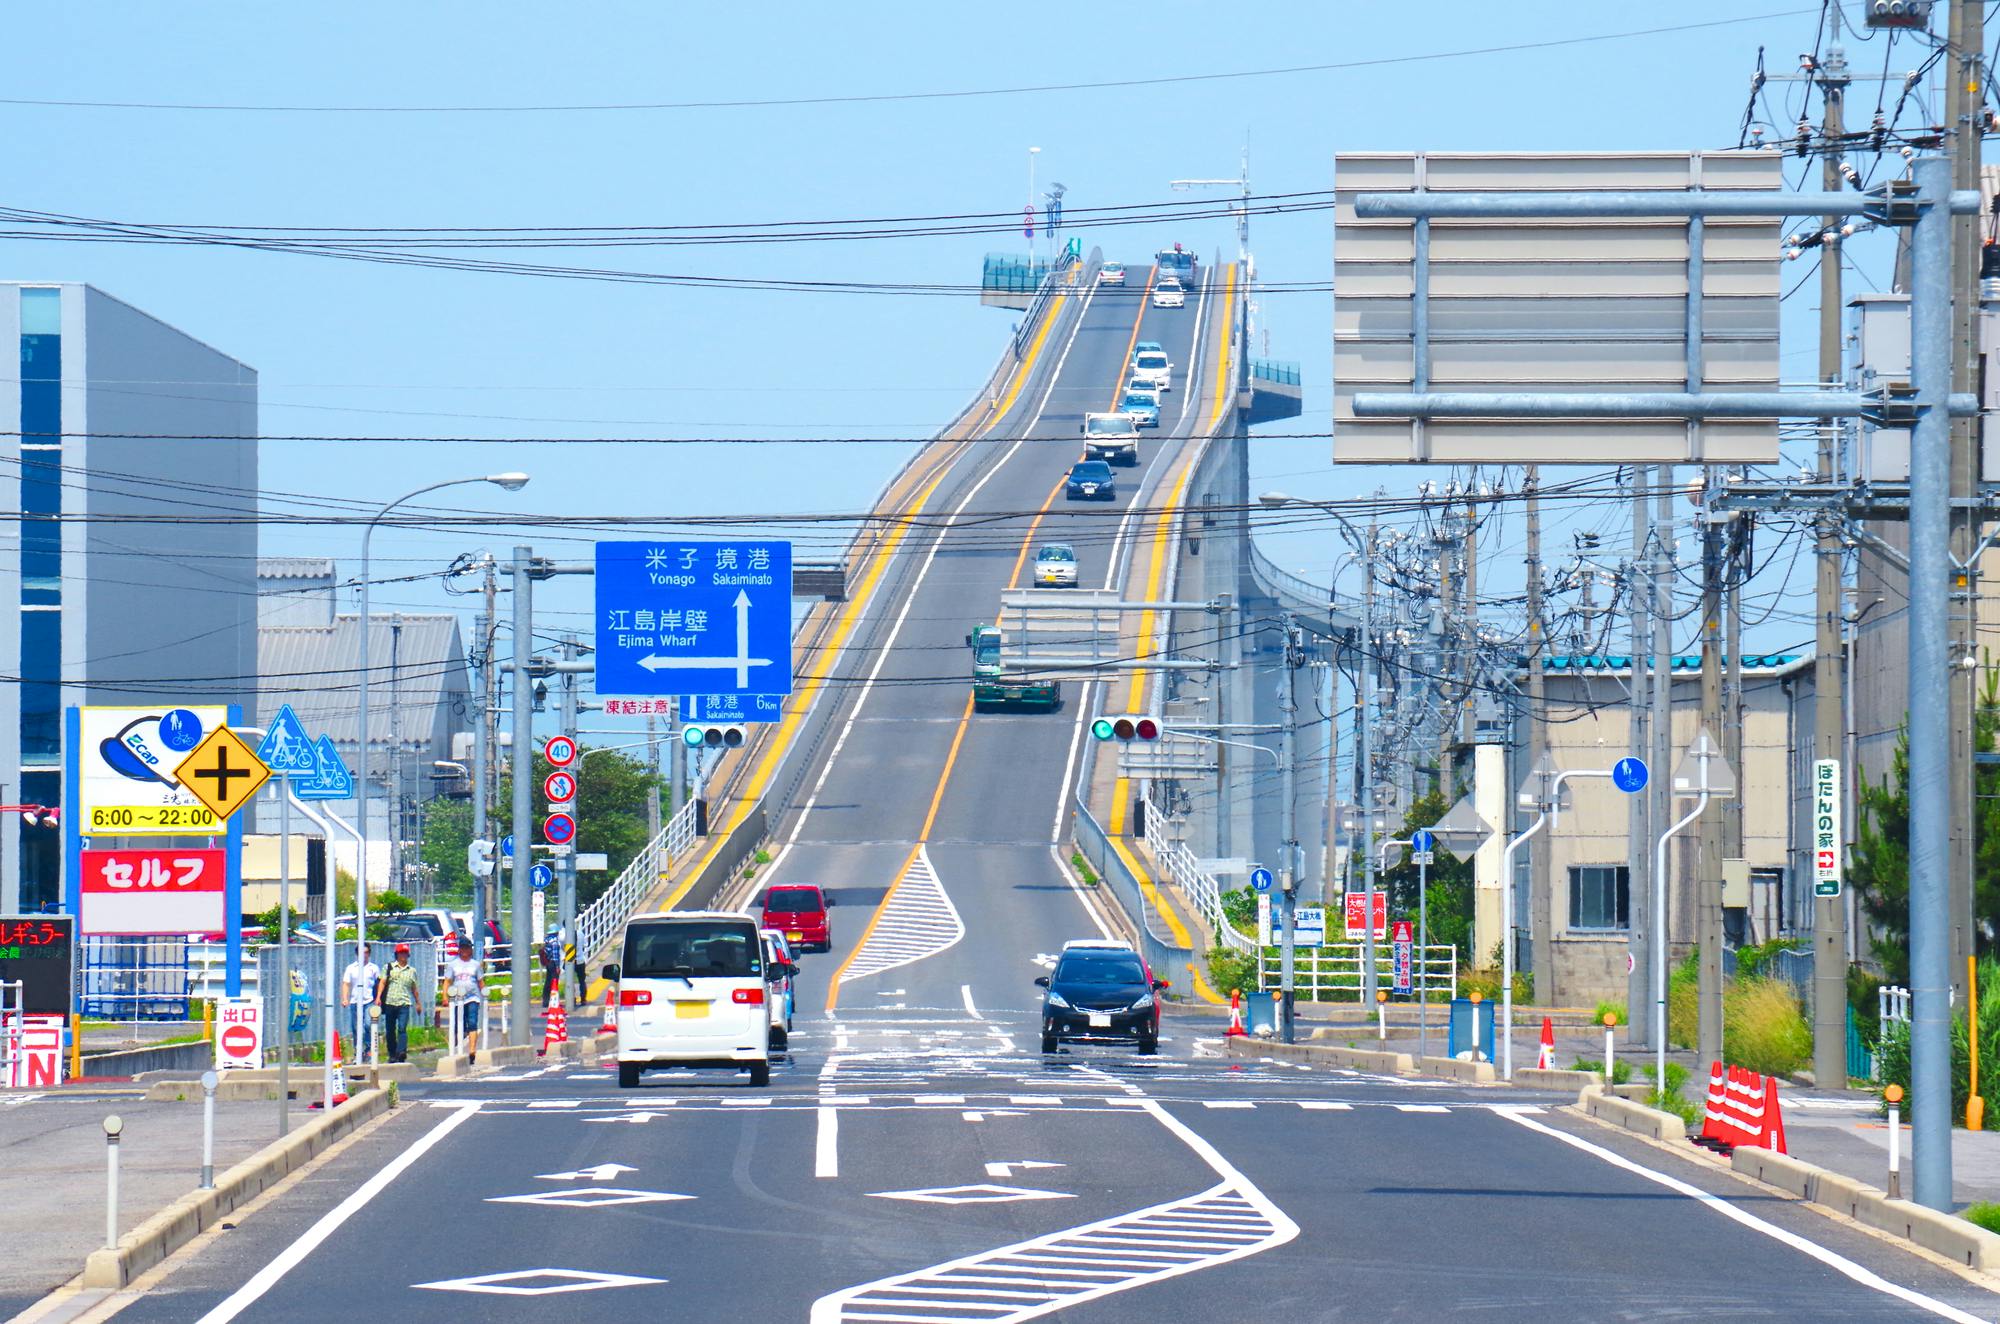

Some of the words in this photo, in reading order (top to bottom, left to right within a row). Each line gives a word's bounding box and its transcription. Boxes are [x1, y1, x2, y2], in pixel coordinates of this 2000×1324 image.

[645, 547, 700, 570] 米子
[715, 547, 771, 570] 境港
[649, 572, 696, 587] Yonago
[712, 572, 773, 586] Sakaiminato
[608, 608, 708, 632] 江島岸壁
[618, 634, 654, 648] Ejima
[660, 634, 697, 647] Wharf
[605, 699, 669, 715] 凍結注意
[706, 695, 739, 710] 境港
[706, 710, 745, 720] Sakaiminato
[551, 744, 570, 759] 40
[93, 809, 133, 826] 6:00
[159, 809, 213, 825] 22:00
[101, 858, 205, 888] セルフ
[0, 921, 65, 945] レギュラー
[223, 1008, 257, 1023] 出口
